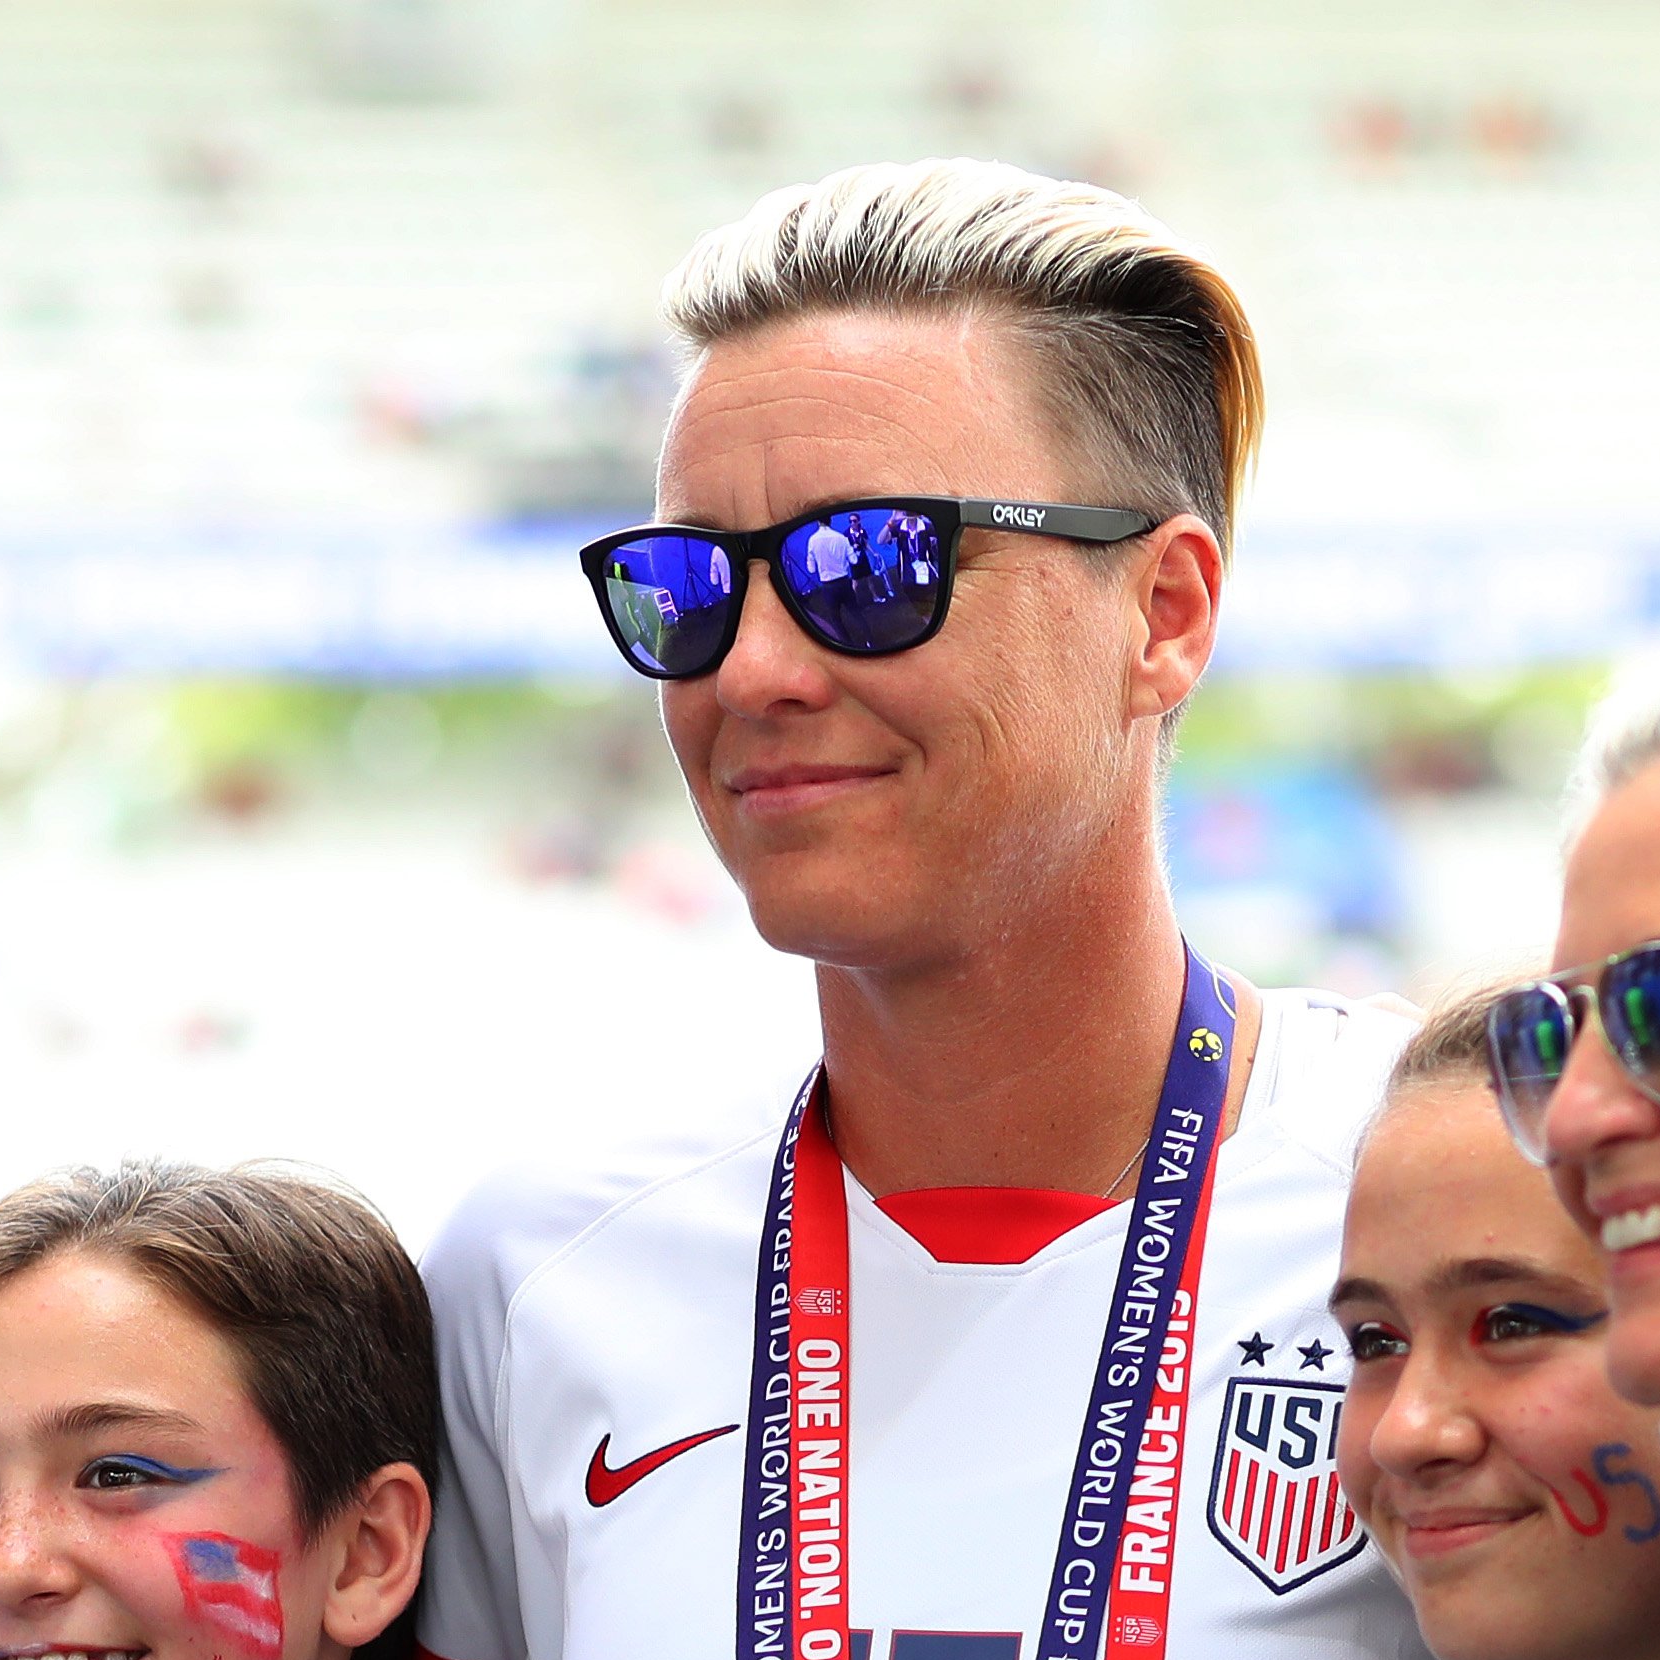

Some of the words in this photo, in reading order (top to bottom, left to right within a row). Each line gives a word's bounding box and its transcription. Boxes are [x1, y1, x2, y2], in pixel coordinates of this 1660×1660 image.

[992, 502, 1048, 528] OAKLEY
[1152, 1106, 1206, 1187] FIFA
[768, 1281, 792, 1364] CUP
[1107, 1197, 1182, 1388] WOMEN'S
[796, 1337, 842, 1430] ONE
[757, 1371, 792, 1521] WORLD
[1070, 1398, 1134, 1549] WORLD
[1234, 1390, 1339, 1471] US
[796, 1437, 842, 1622] NATION.
[1118, 1403, 1182, 1595] FRANCE
[1054, 1557, 1097, 1646] CUP
